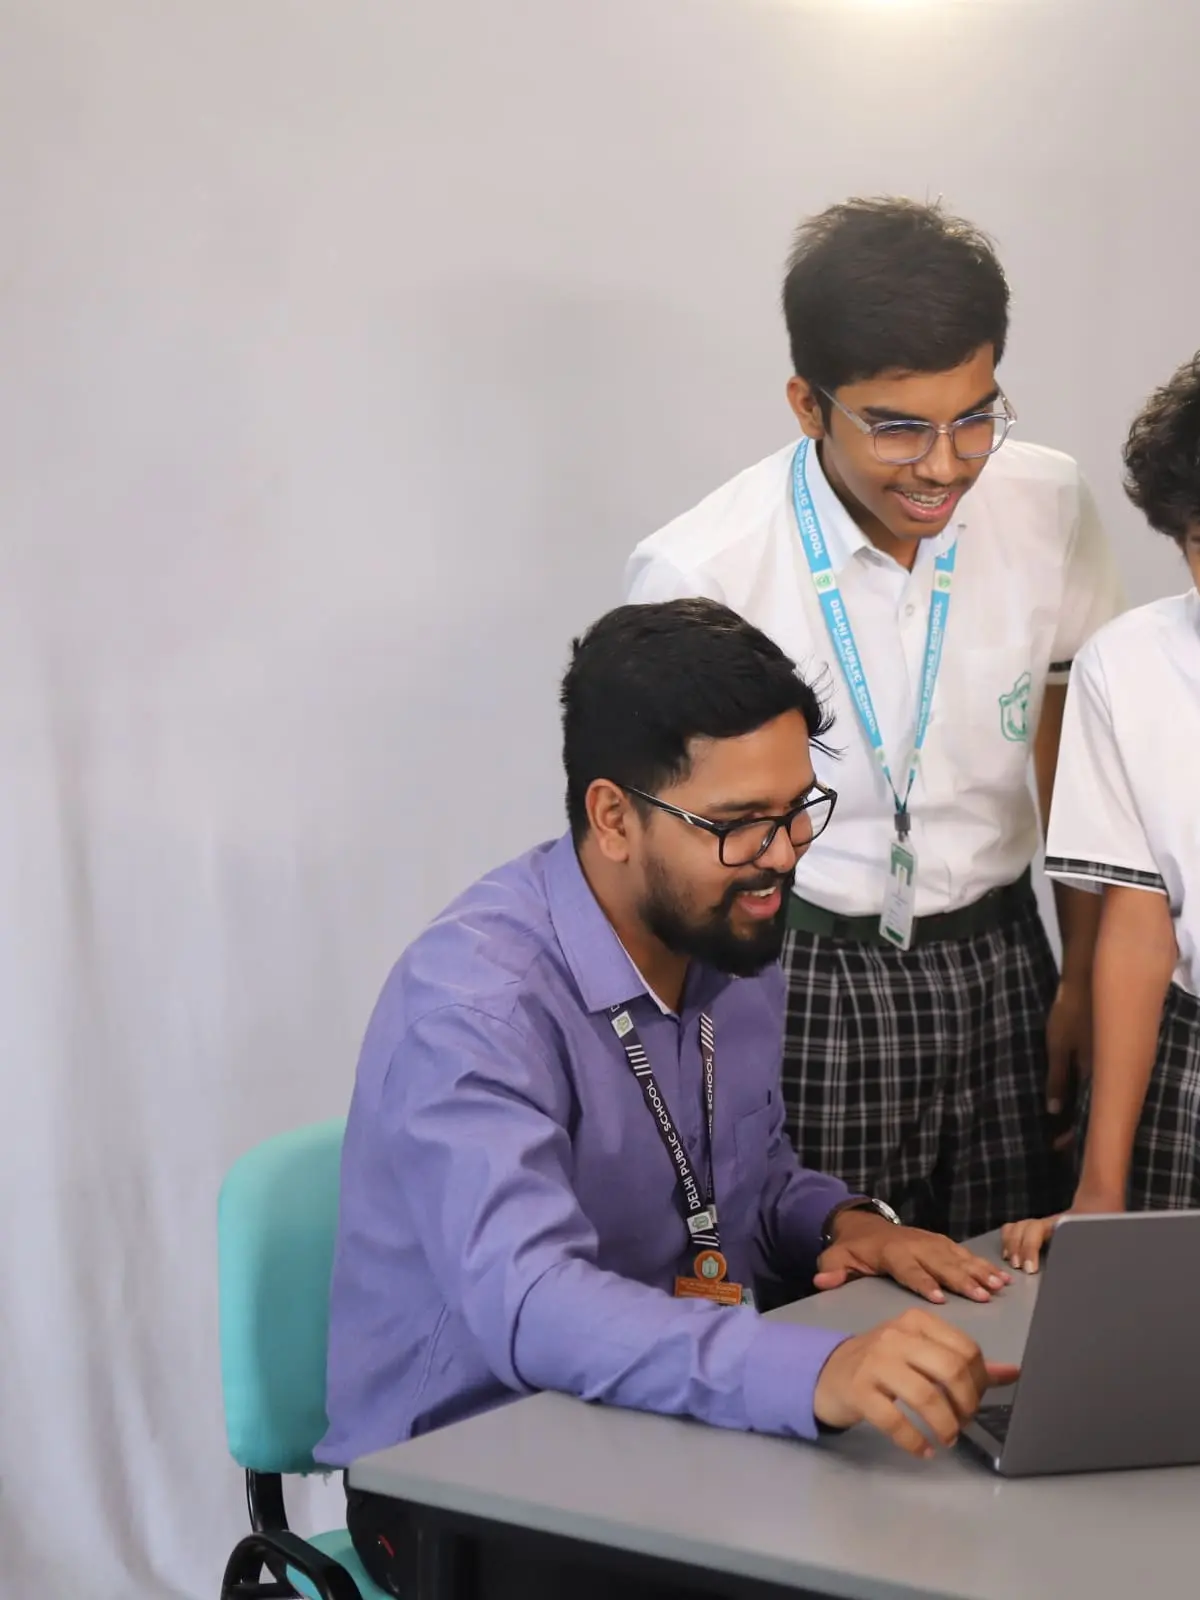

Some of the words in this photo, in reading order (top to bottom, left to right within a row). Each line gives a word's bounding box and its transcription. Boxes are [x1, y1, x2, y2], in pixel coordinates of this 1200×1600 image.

[802, 508, 825, 559] SCHOOL
[929, 601, 943, 651] SCHOOL
[830, 599, 849, 635] DELHI
[841, 635, 863, 683] PUBLIC
[855, 684, 878, 735] SCHOOL
[646, 1079, 672, 1132] SCHOOL
[668, 1132, 690, 1176] PUBLIC
[683, 1176, 701, 1210] DELHI
